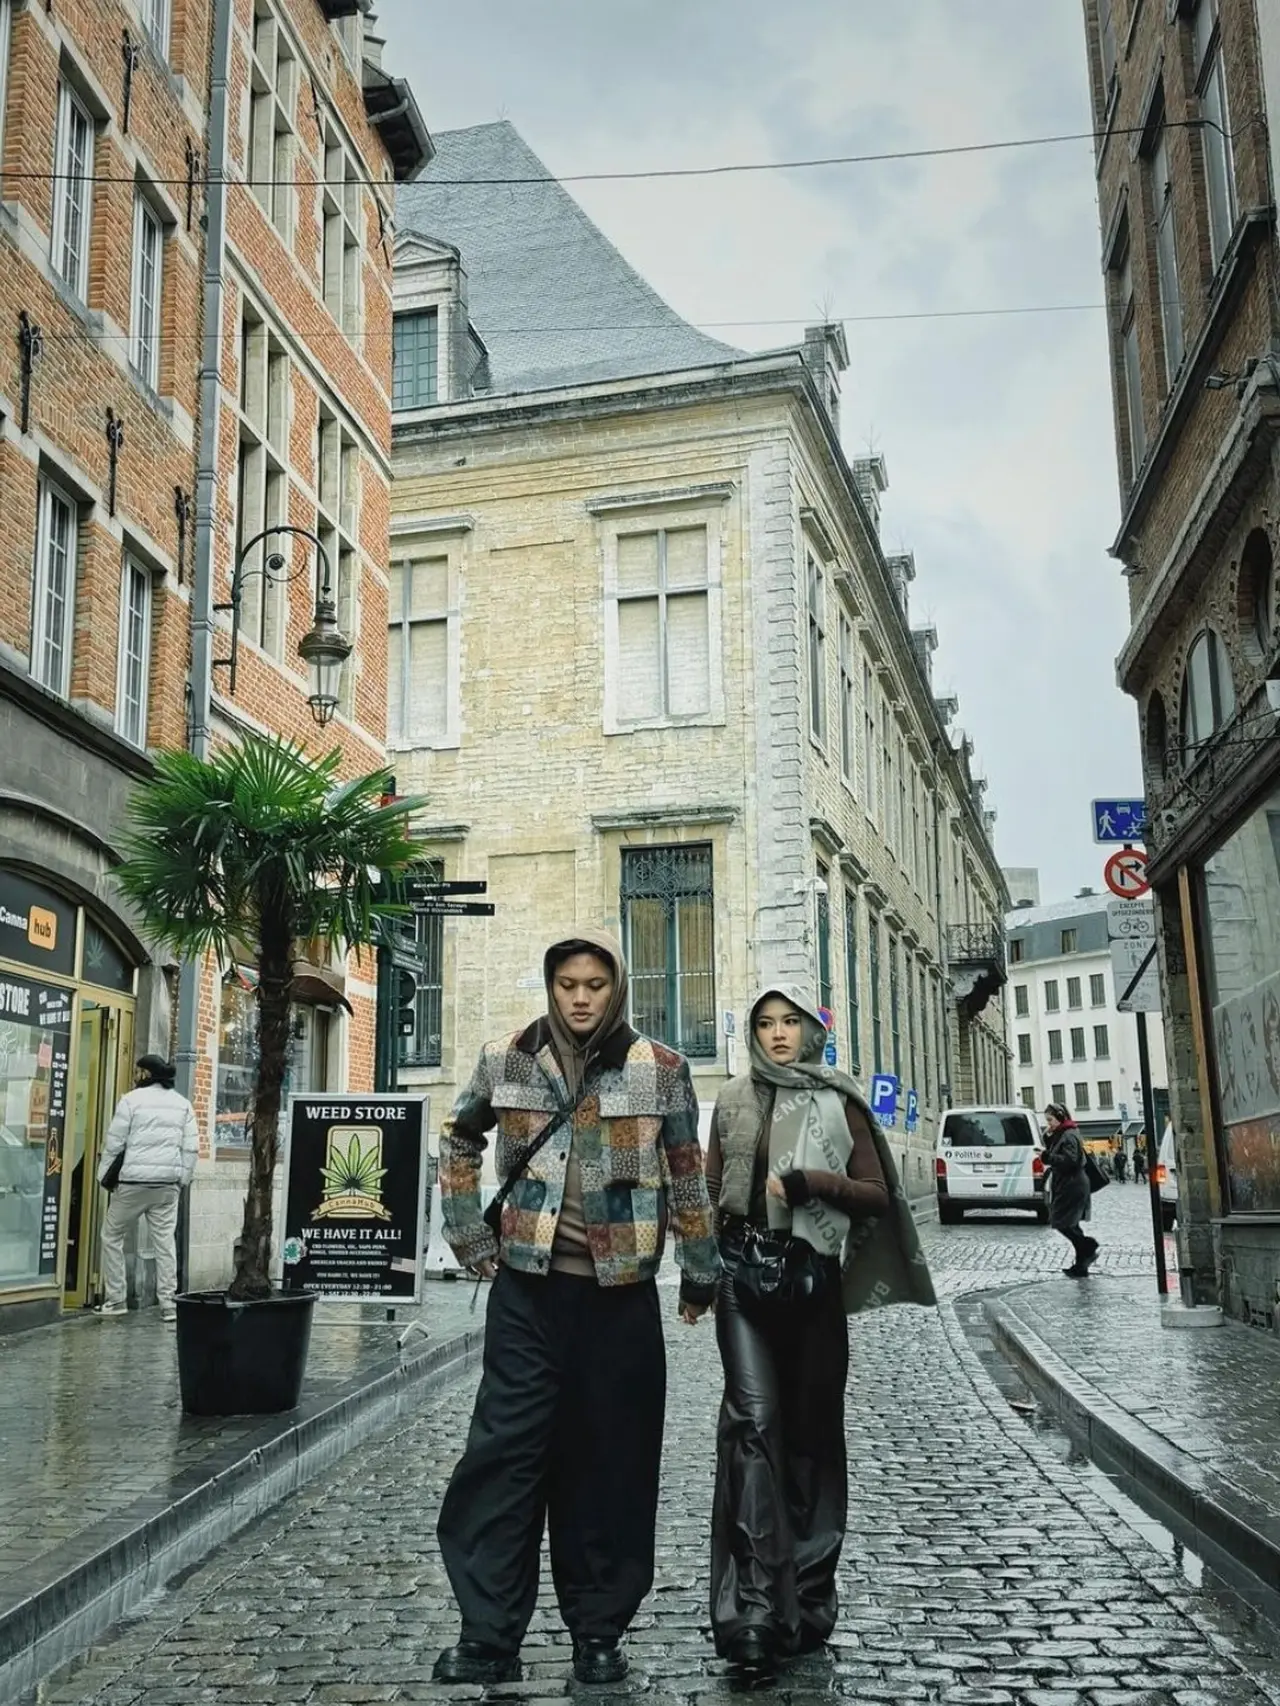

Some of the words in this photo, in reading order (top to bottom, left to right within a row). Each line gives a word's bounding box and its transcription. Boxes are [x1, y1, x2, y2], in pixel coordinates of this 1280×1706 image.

[0, 906, 28, 931] Canna
[34, 918, 52, 938] hub
[0, 982, 30, 1016] STORE
[874, 1080, 893, 1106] P
[306, 1106, 351, 1120] WEED
[354, 1106, 406, 1120] STORE
[908, 1094, 916, 1116] P
[954, 1150, 980, 1158] Politie
[302, 1228, 321, 1240] WE
[324, 1228, 356, 1240] HAVE
[359, 1229, 373, 1240] IT
[374, 1229, 402, 1240] ALL!
